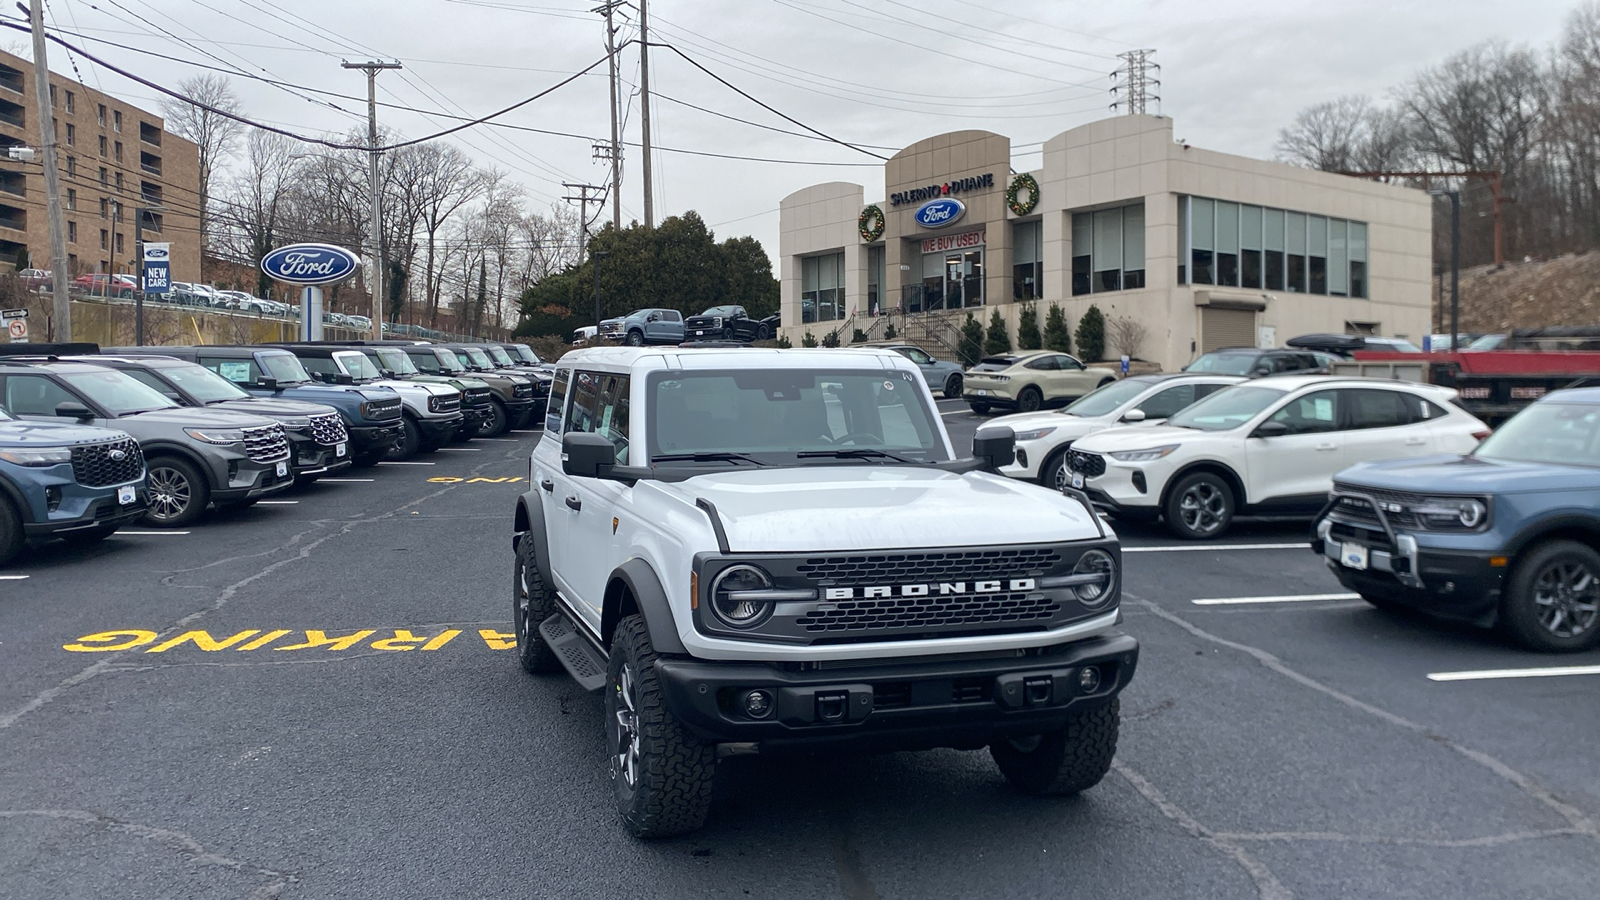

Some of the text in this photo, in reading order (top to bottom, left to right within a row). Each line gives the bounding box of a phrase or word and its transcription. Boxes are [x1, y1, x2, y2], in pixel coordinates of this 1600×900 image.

[890, 173, 994, 206] SALERNO DUANE
[923, 204, 951, 223] Ford
[922, 240, 935, 252] WE
[937, 236, 954, 250] BUY
[956, 233, 979, 247] USED
[148, 267, 167, 278] NEW
[280, 252, 335, 275] Ford
[148, 278, 167, 287] CARS
[826, 578, 1035, 600] BRONCO
[62, 628, 518, 653] ARKING
